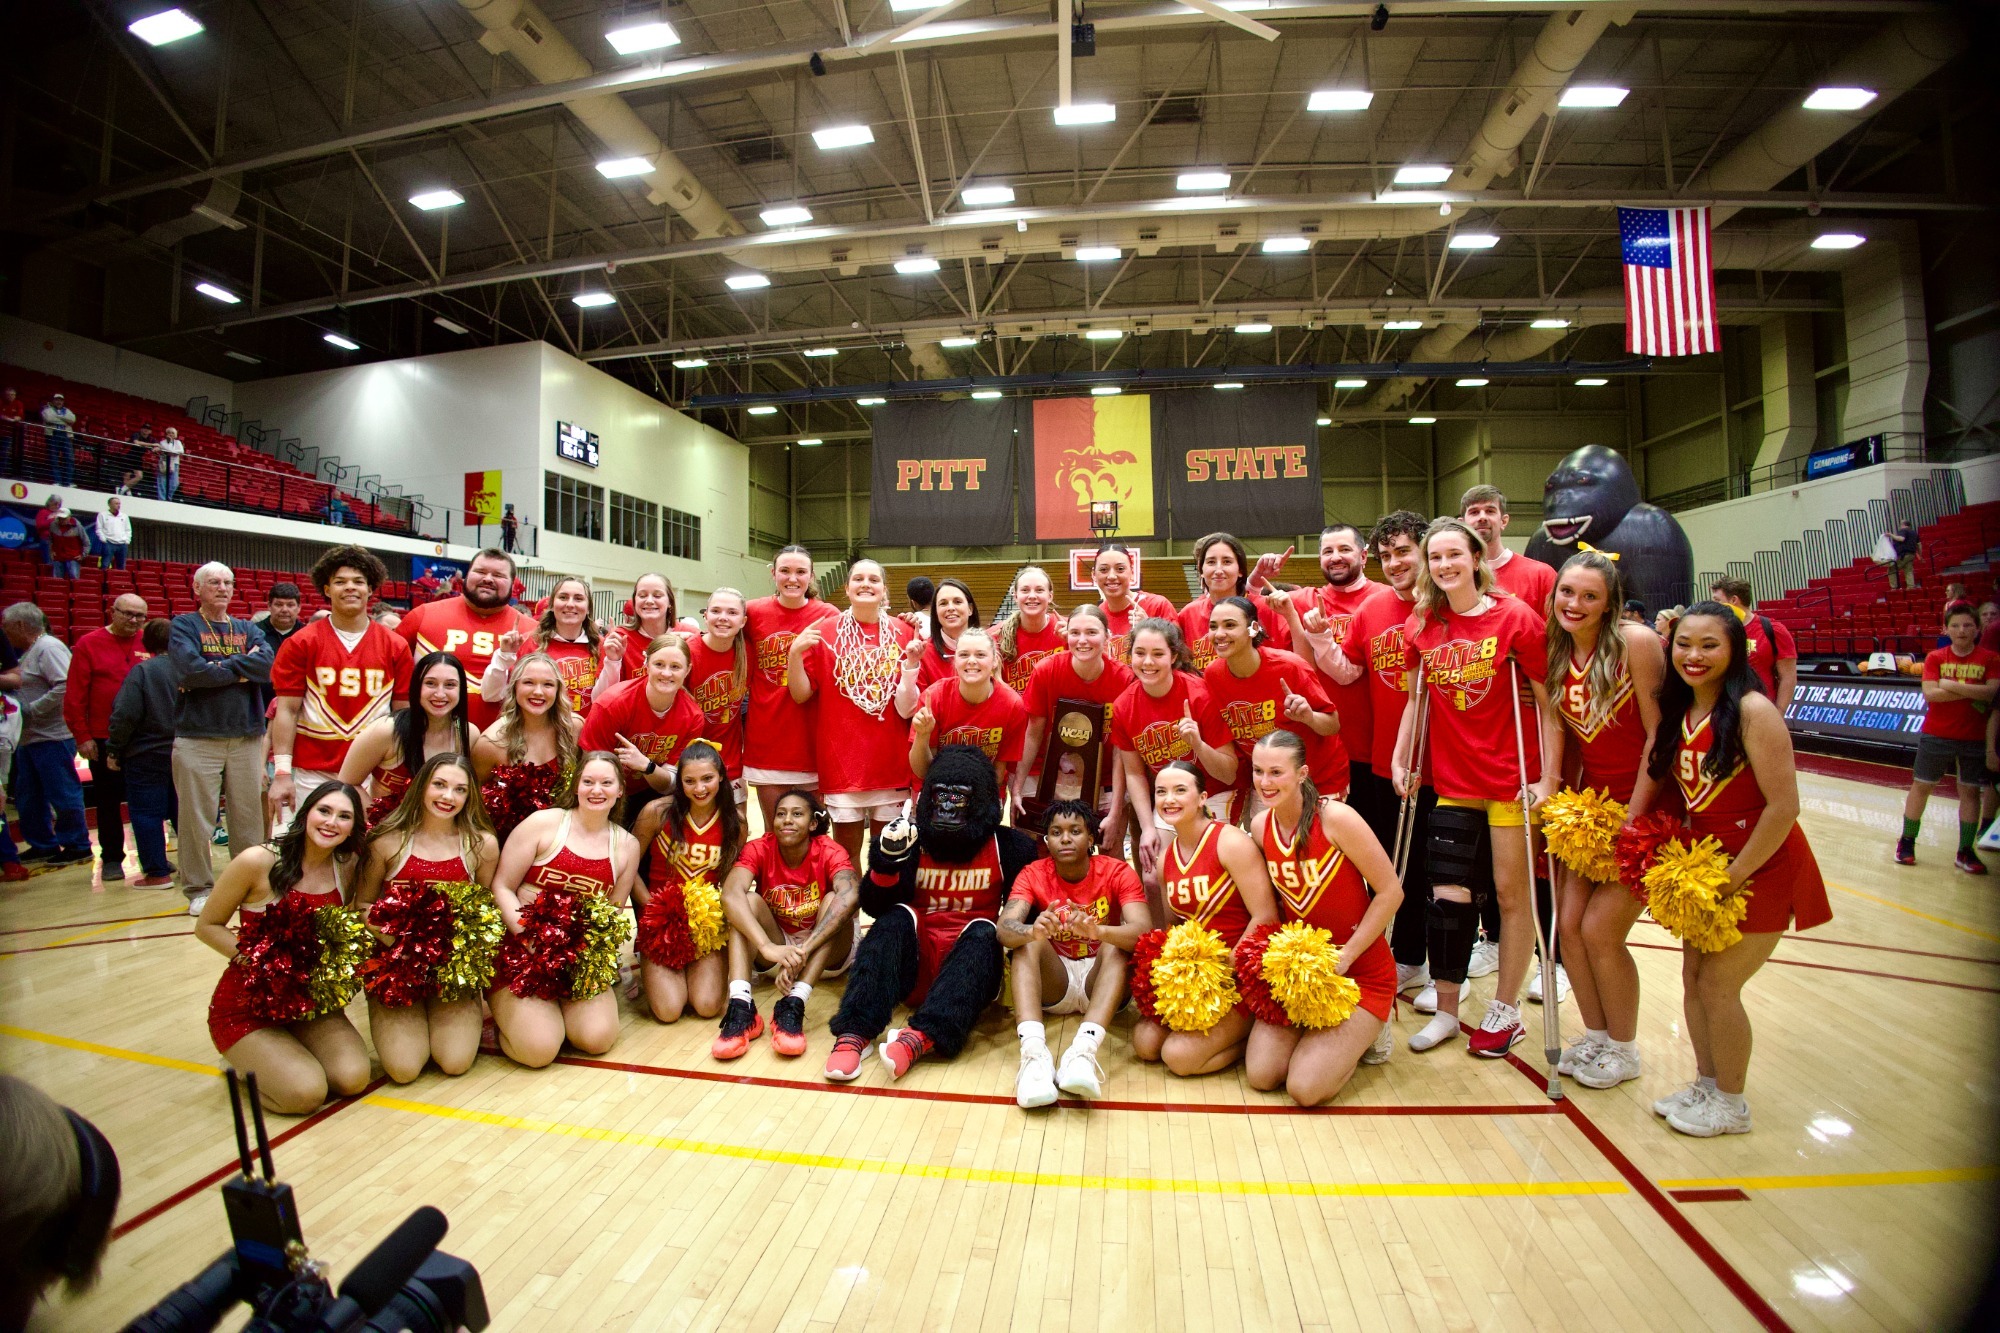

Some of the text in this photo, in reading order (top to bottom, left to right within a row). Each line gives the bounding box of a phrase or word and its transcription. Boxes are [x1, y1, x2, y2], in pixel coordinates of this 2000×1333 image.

[1186, 445, 1308, 482] STATE
[1813, 452, 1849, 470] CHAMPIONS
[896, 458, 986, 491] PITT
[444, 629, 502, 656] PS
[756, 635, 798, 657] ELIT
[1481, 636, 1498, 659] 8
[758, 653, 787, 669] 2025
[315, 666, 386, 698] PSU
[1262, 699, 1276, 721] 8
[1805, 686, 1830, 703] THE
[1828, 688, 1864, 706] NCAA
[1862, 690, 1926, 711] DIVISION
[1797, 705, 1850, 725] CENTRAL
[1849, 710, 1904, 731] REGION
[664, 734, 679, 751] 8
[989, 727, 1003, 744] 8
[1060, 726, 1091, 741] NCAA
[915, 867, 992, 892] PITT STATE
[1268, 858, 1322, 889] PSU
[810, 880, 820, 901] 8
[1166, 875, 1211, 905] PSU
[1096, 896, 1110, 919] 8
